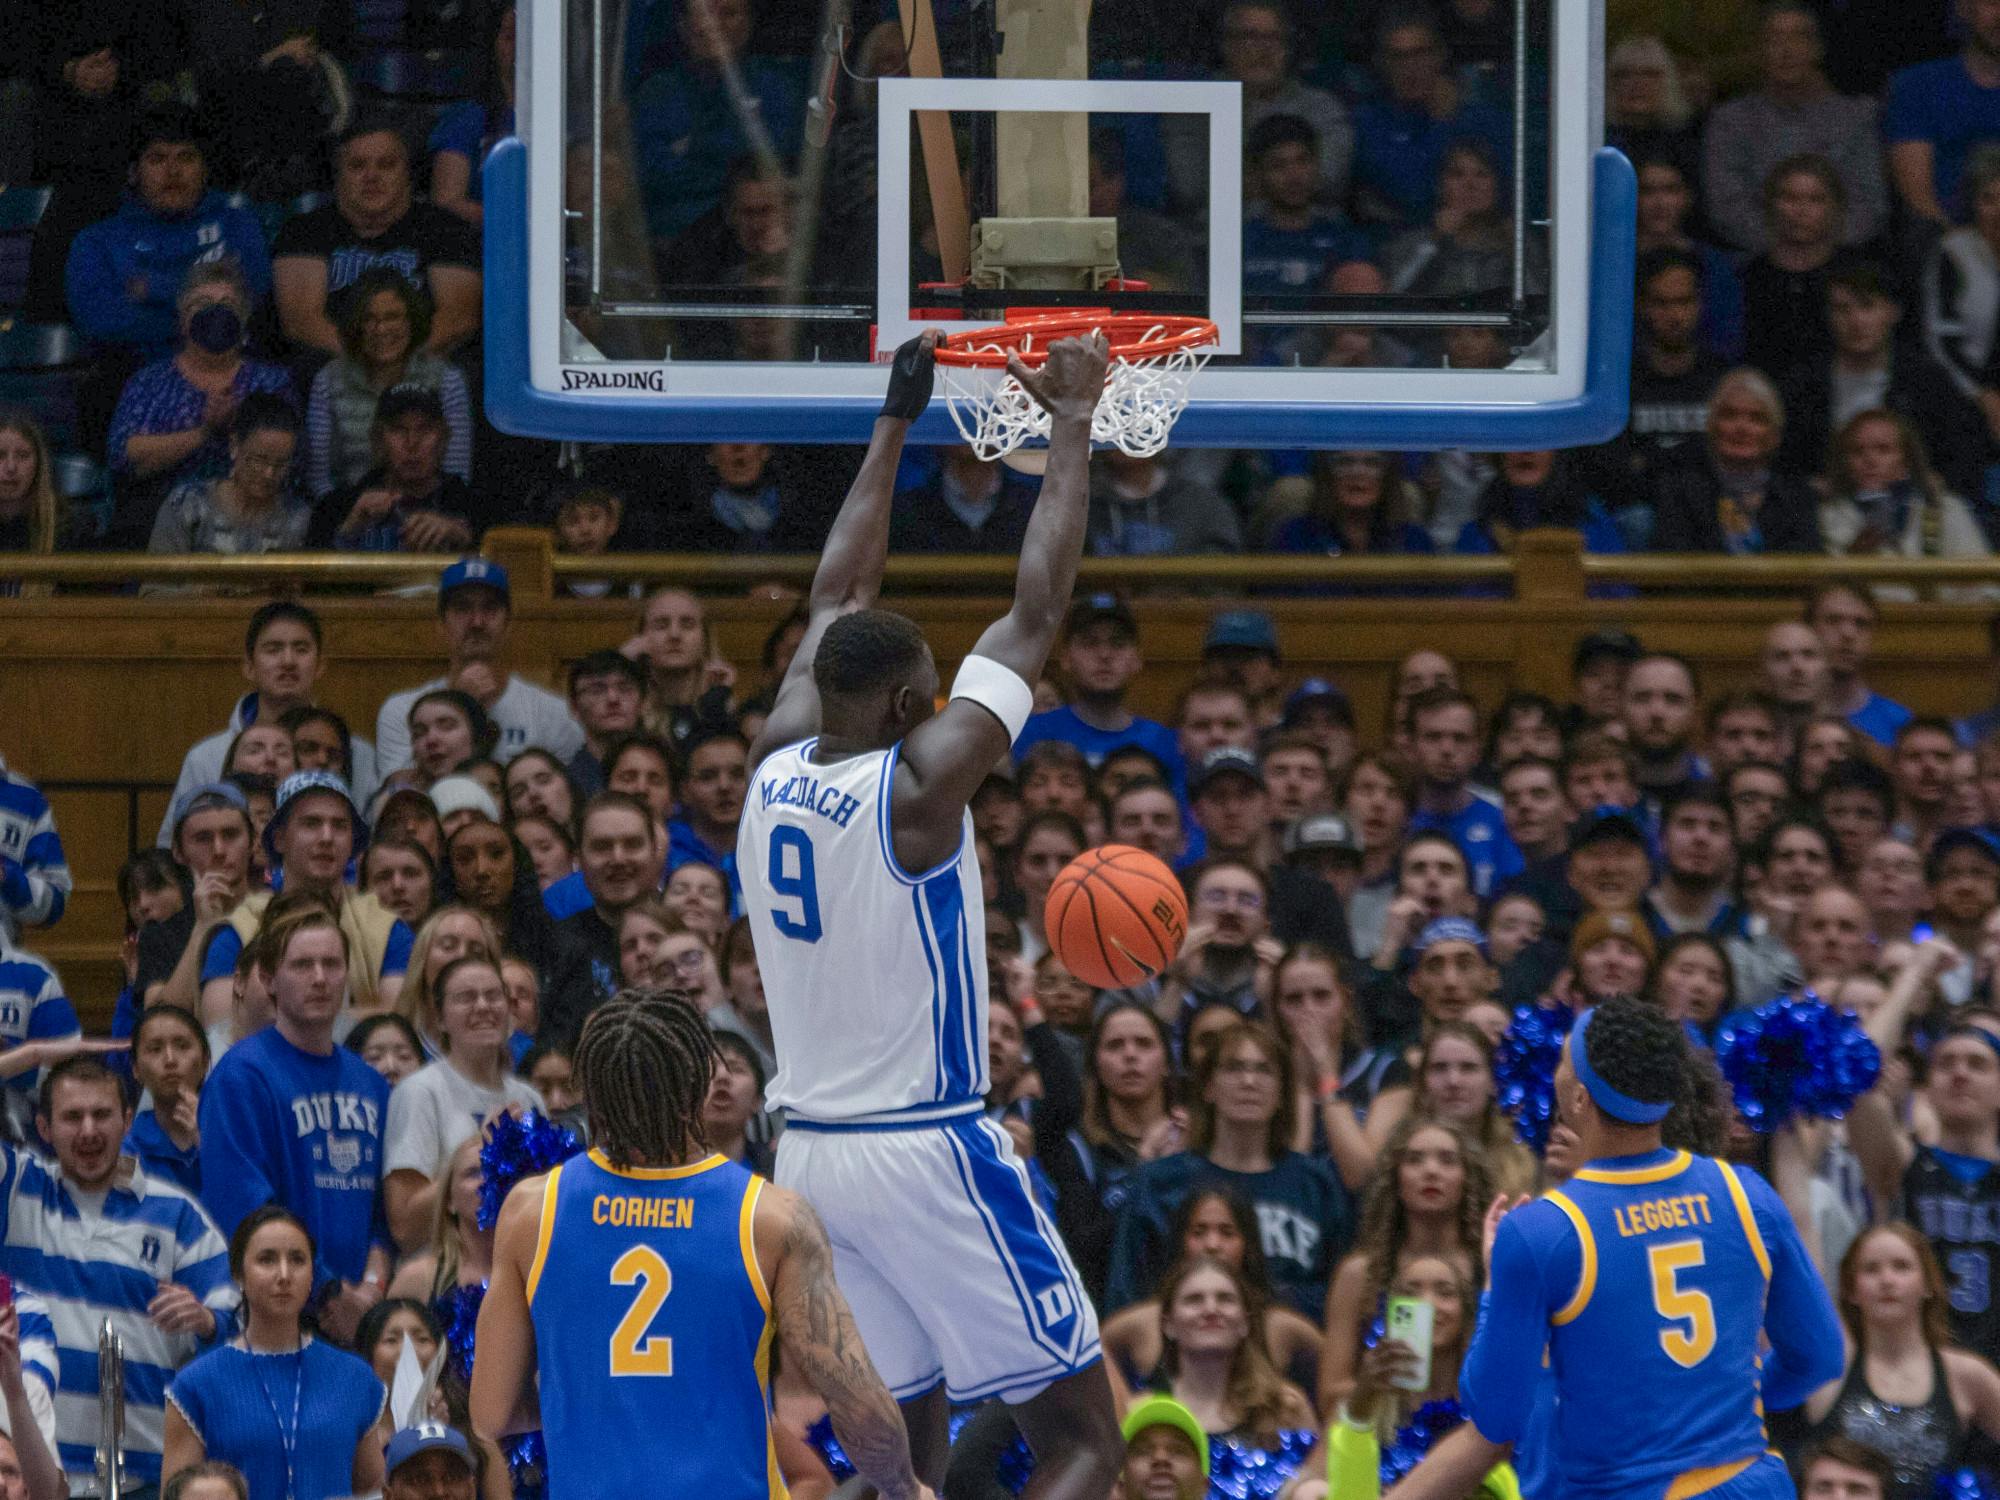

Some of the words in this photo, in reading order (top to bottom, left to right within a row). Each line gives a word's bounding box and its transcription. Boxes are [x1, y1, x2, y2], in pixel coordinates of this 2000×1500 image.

[561, 368, 666, 392] SPALDING
[761, 776, 860, 829] MALUACH
[768, 824, 823, 945] 9
[592, 1194, 694, 1229] CORHEN
[1614, 1194, 1713, 1237] LEGGETT
[610, 1244, 672, 1377] 2
[1036, 1282, 1073, 1328] D
[1648, 1240, 1717, 1369] 5
